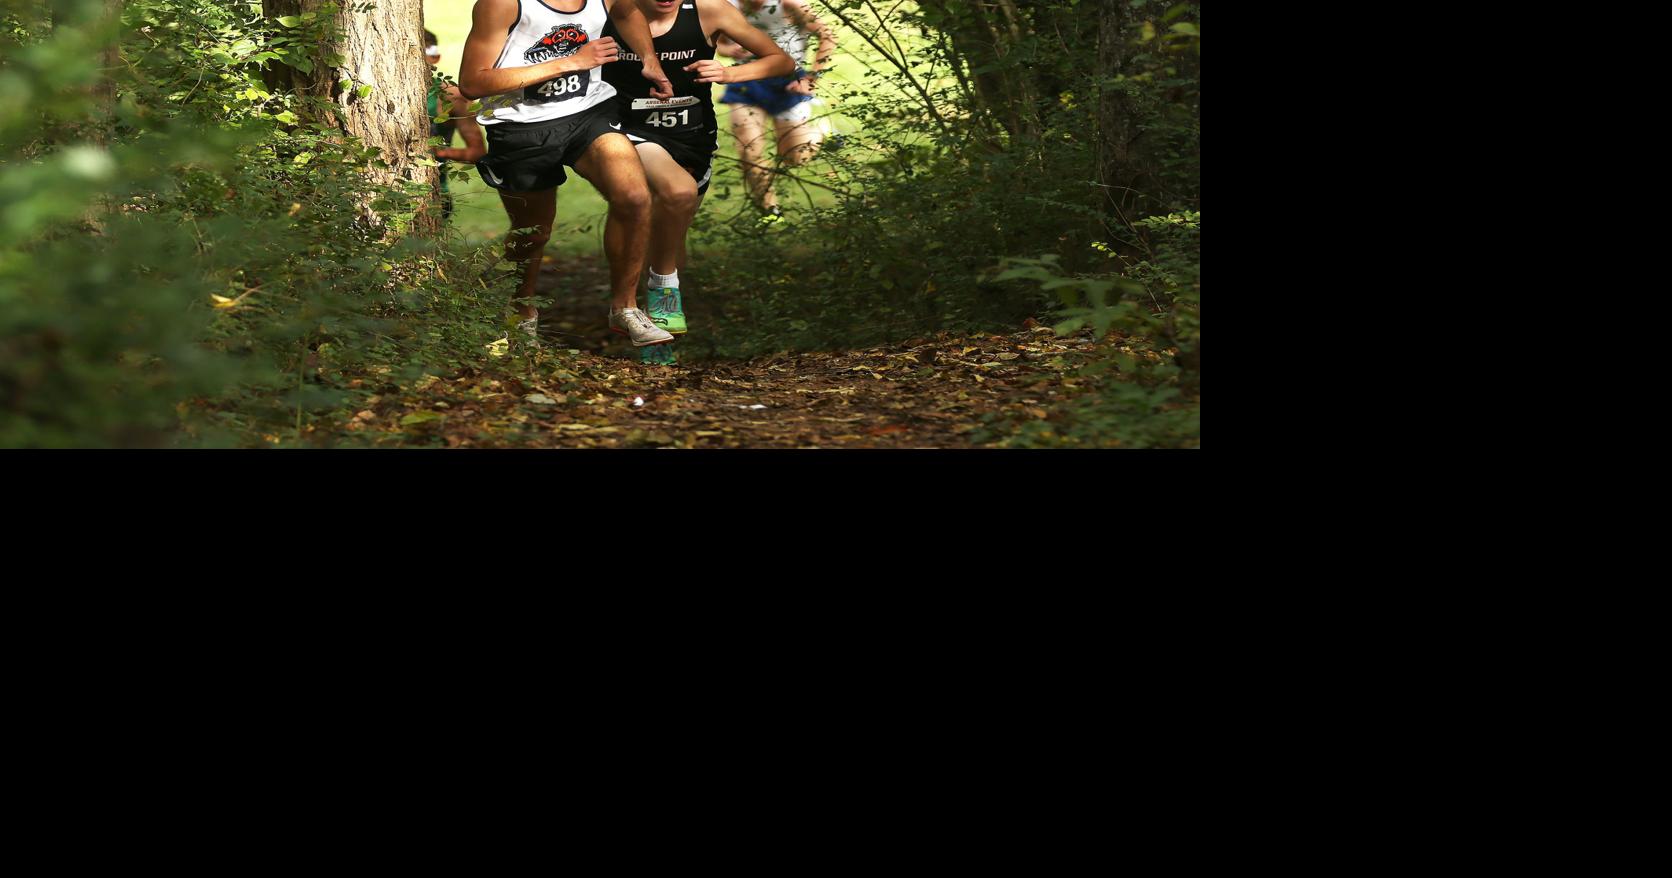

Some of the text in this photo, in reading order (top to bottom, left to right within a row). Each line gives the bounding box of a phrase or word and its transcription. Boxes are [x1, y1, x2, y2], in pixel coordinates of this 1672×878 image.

[660, 49, 697, 61] POINT
[537, 74, 581, 97] 498
[645, 109, 689, 128] 451
